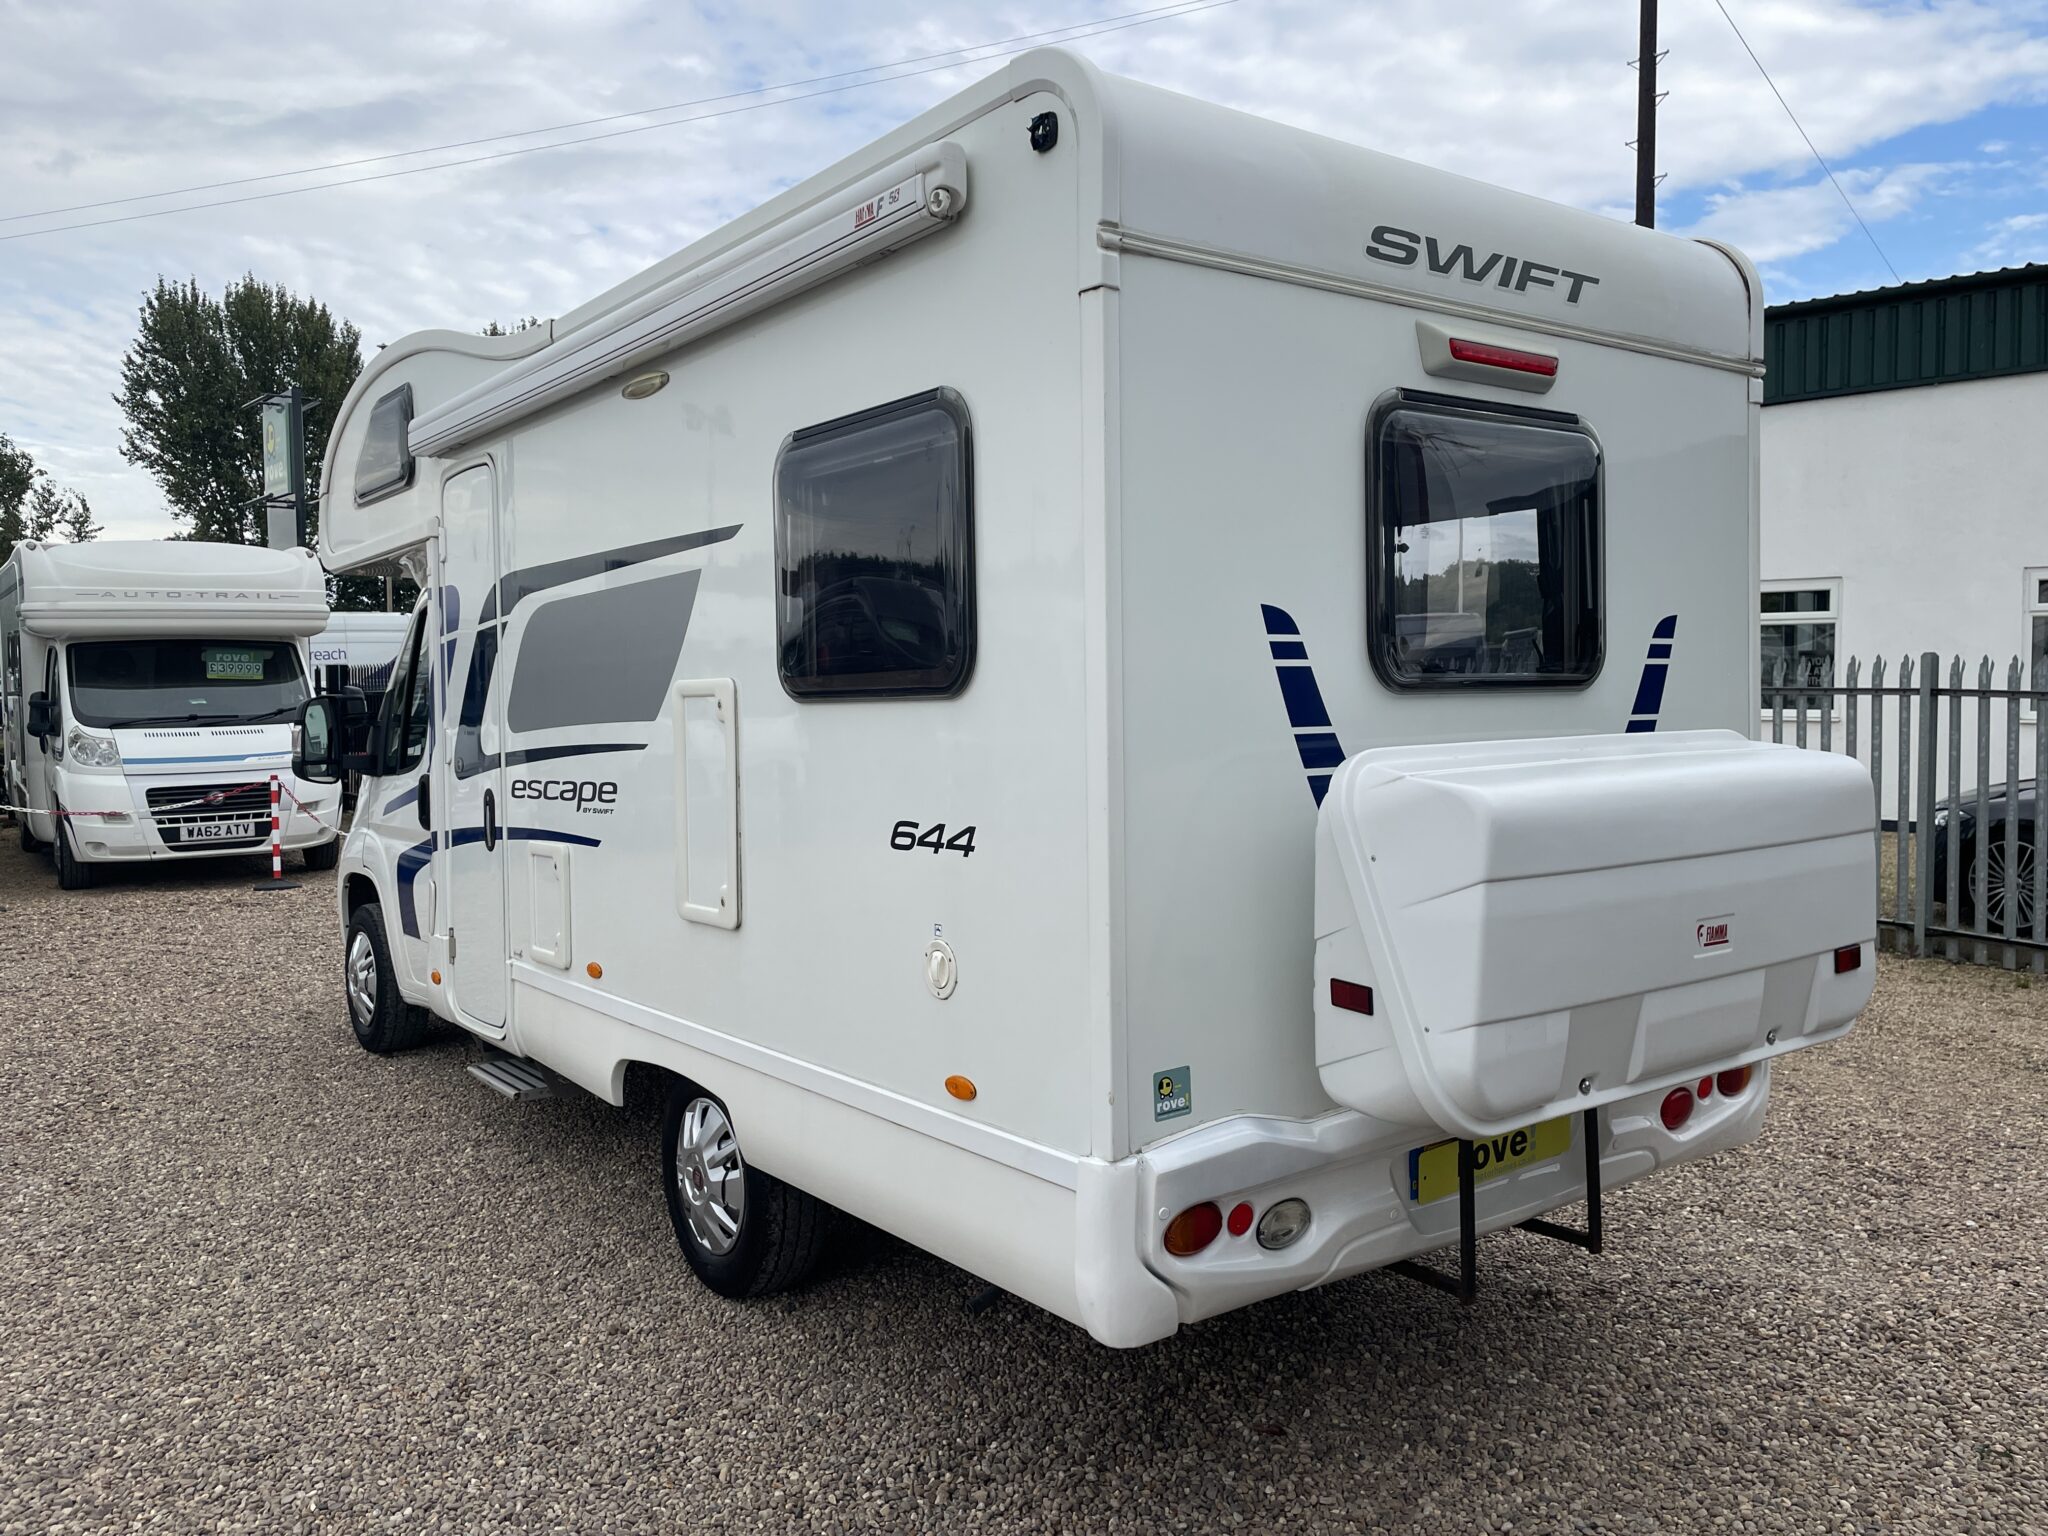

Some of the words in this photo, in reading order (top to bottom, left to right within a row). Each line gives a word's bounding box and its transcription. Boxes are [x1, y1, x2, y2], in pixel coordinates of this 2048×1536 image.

[1365, 225, 1600, 304] SWIFT
[100, 591, 280, 600] AUTO-TRAIL
[210, 662, 261, 673] £39999
[511, 779, 618, 813] escape
[592, 807, 615, 815] SWIFT
[187, 825, 222, 838] WA62
[225, 823, 250, 836] ATV
[890, 820, 977, 858] 644
[1472, 1123, 1537, 1171] ove!
